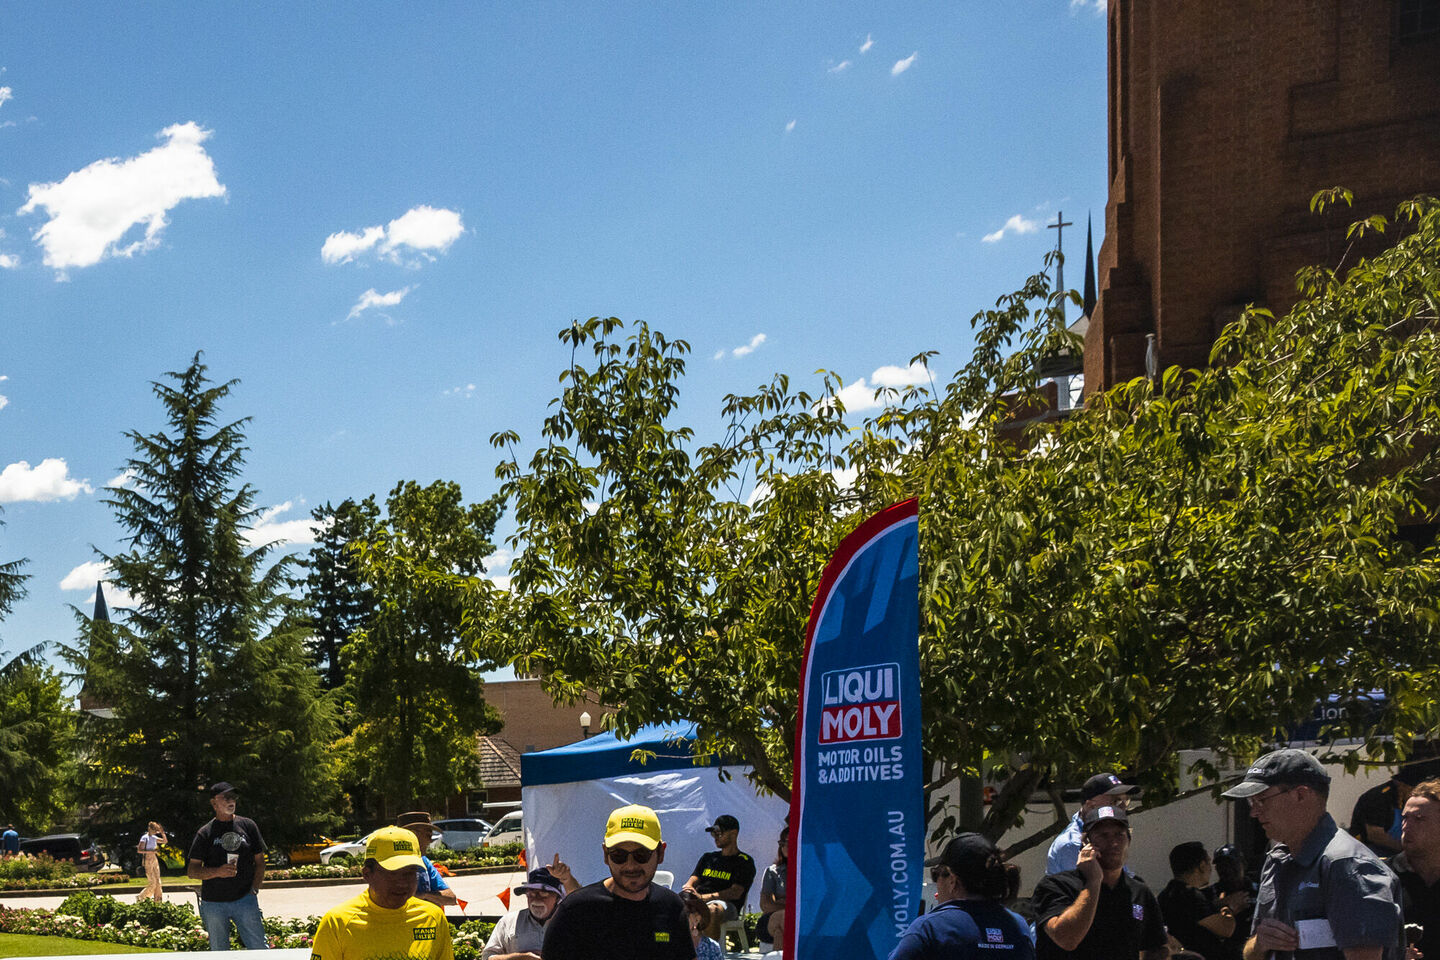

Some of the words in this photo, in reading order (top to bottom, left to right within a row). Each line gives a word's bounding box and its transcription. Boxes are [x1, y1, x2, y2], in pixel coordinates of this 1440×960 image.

[824, 668, 894, 705] LIQUI
[822, 703, 898, 740] MOLY
[818, 748, 860, 767] MOTOR
[863, 745, 903, 763] OILS
[818, 763, 904, 784] &ADDITIVES
